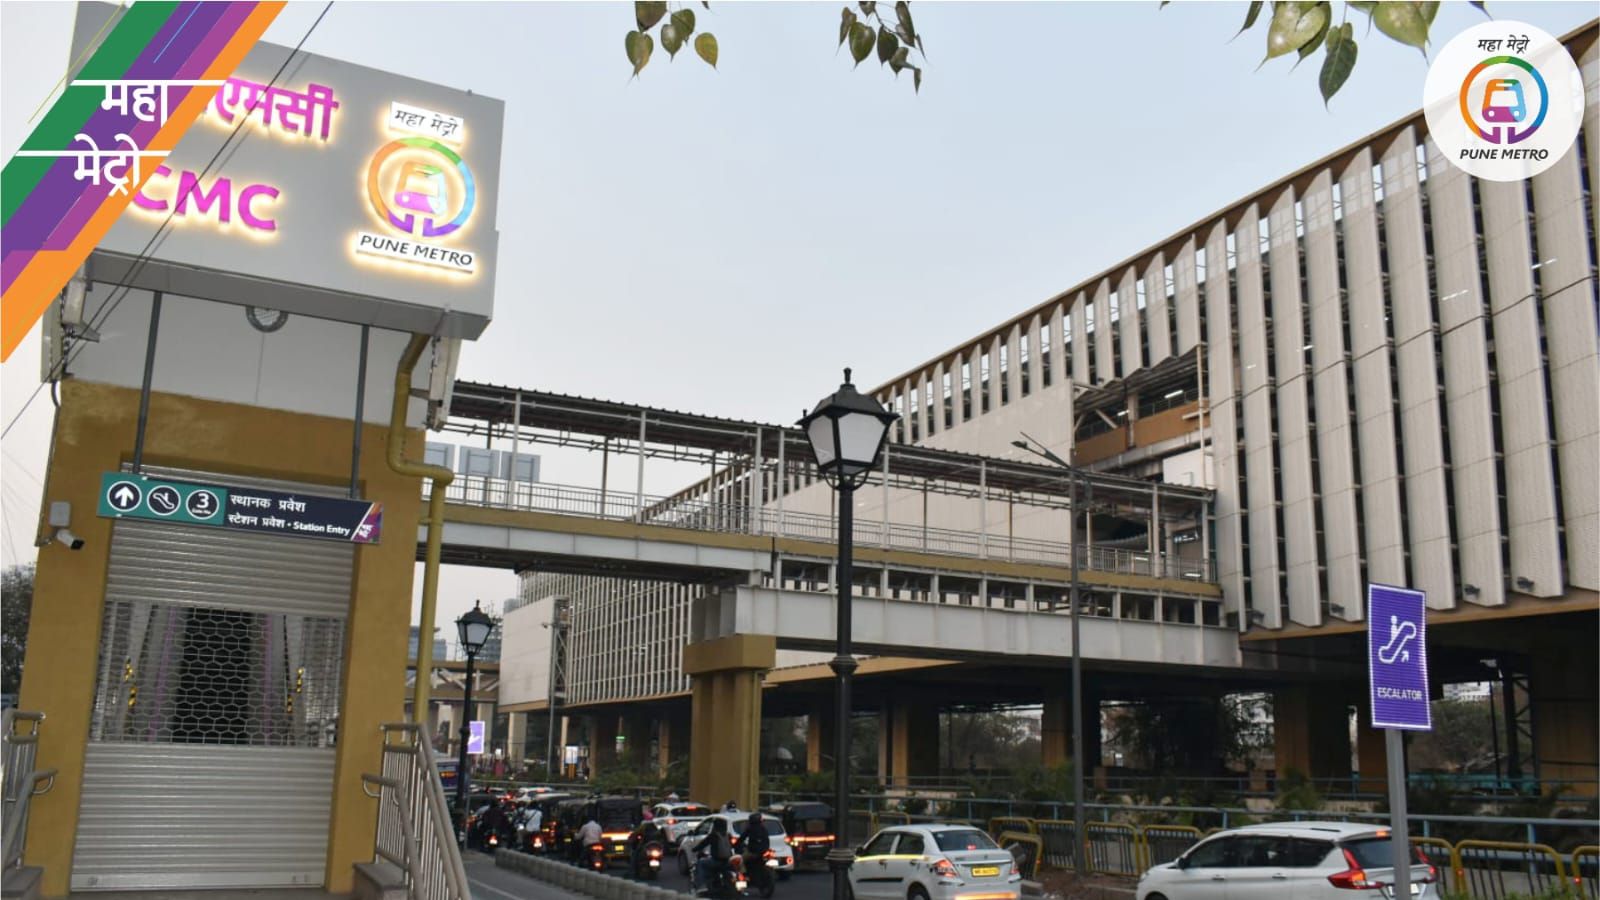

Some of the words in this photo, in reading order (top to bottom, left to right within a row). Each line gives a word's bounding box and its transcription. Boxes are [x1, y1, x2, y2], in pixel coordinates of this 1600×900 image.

[203, 77, 339, 142] एमसी
[395, 110, 425, 127] महा
[430, 113, 459, 137] मेट्रो
[360, 235, 410, 254] PUNE
[413, 244, 473, 267] METRO
[196, 493, 210, 509] 3
[230, 494, 272, 509] स्थानक
[278, 498, 306, 513] प्रवेश
[228, 512, 258, 526] स्टेशन
[261, 516, 286, 529] प्रवेश
[293, 521, 325, 533] Station
[326, 524, 350, 537] Entry
[1377, 686, 1423, 701] ESCALATOR
